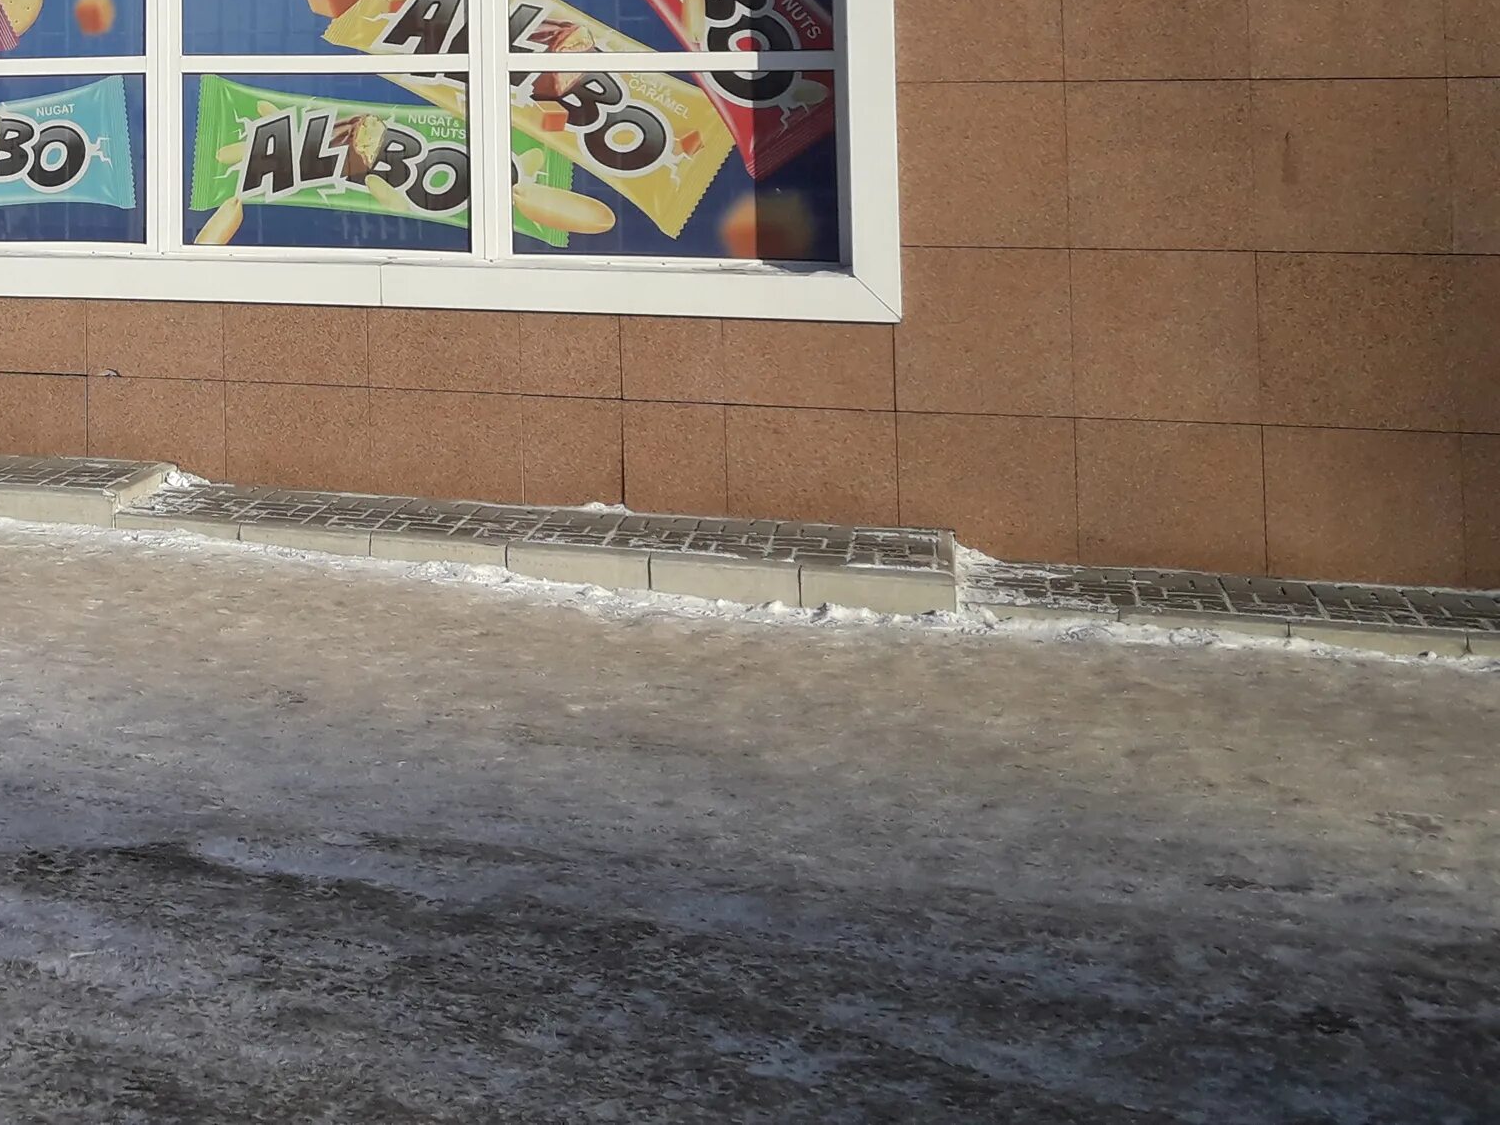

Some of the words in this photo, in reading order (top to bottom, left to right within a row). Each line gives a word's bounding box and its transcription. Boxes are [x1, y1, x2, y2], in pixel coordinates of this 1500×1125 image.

[628, 78, 689, 119] CARAMEL
[36, 102, 75, 117] NUGAT
[430, 127, 466, 140] NUTS
